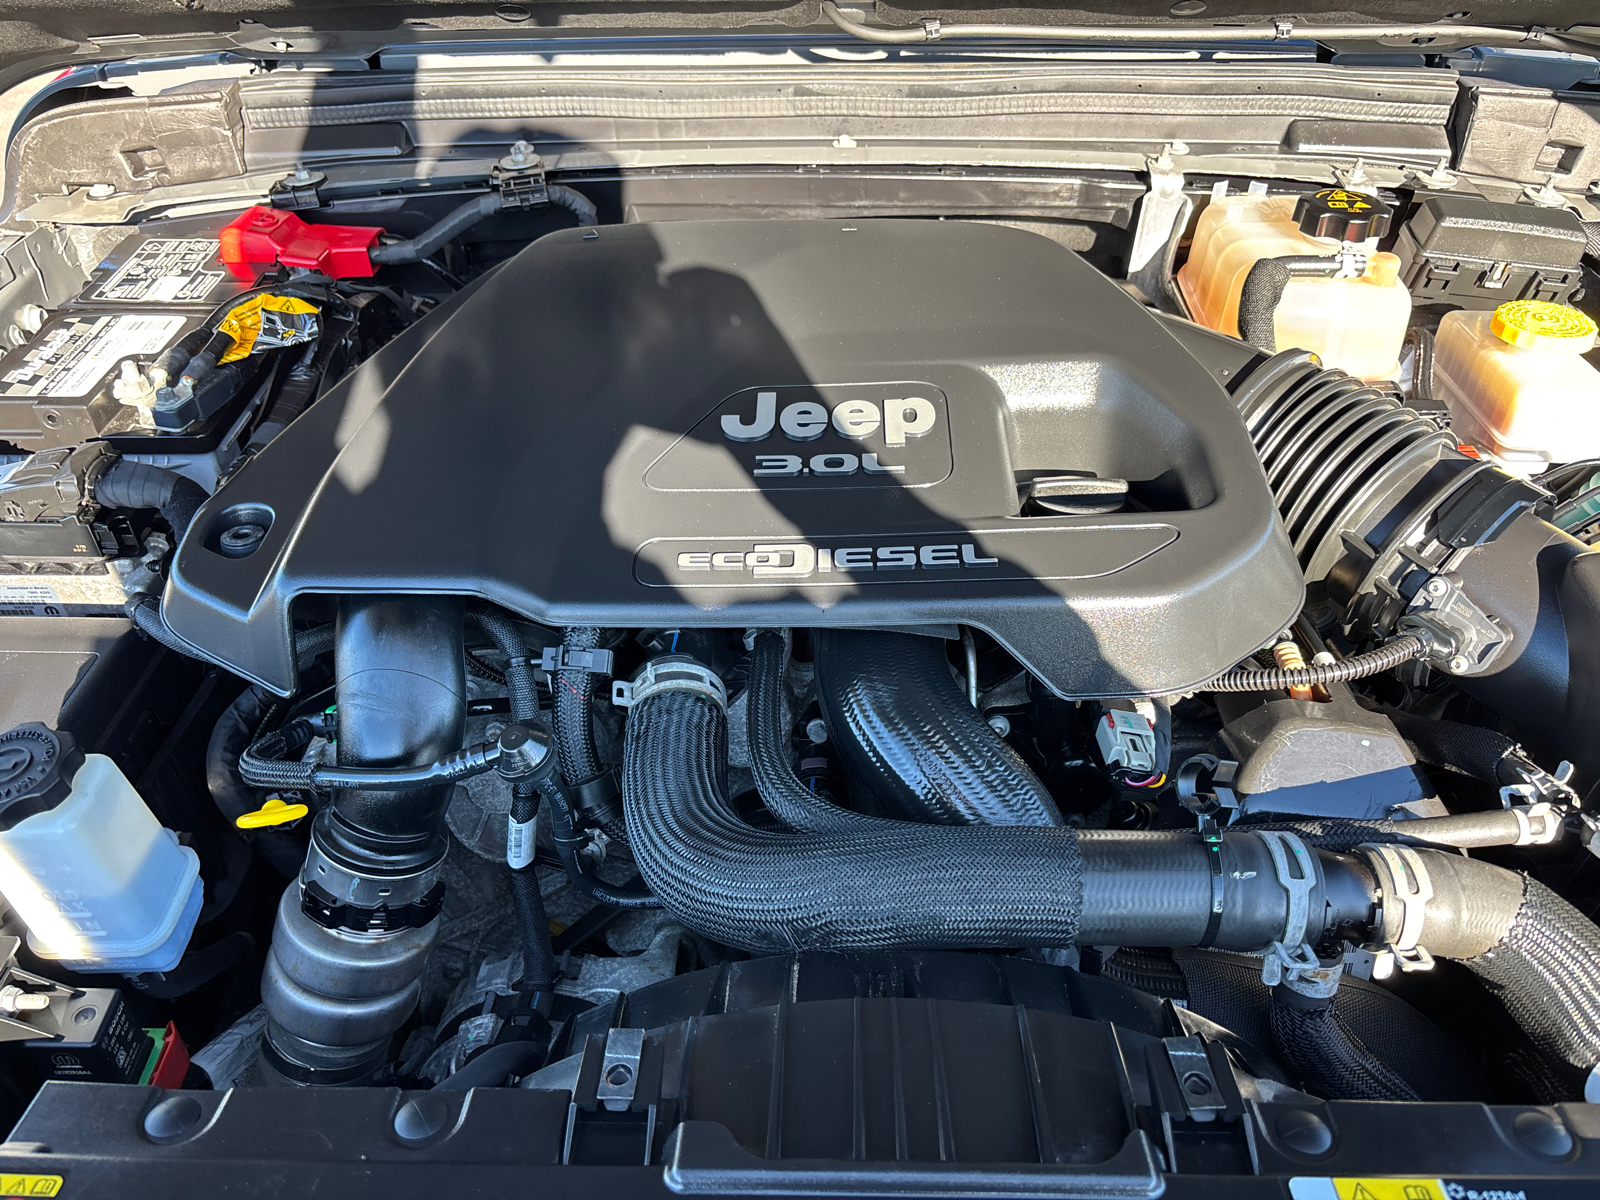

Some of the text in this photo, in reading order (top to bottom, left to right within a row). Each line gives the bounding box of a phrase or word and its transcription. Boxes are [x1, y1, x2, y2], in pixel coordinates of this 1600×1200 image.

[720, 392, 937, 447] Jeep
[753, 453, 905, 477] 3.0L
[592, 887, 617, 905] VACUUM
[619, 898, 641, 908] BRAKE
[108, 1000, 125, 1034] BOSCH
